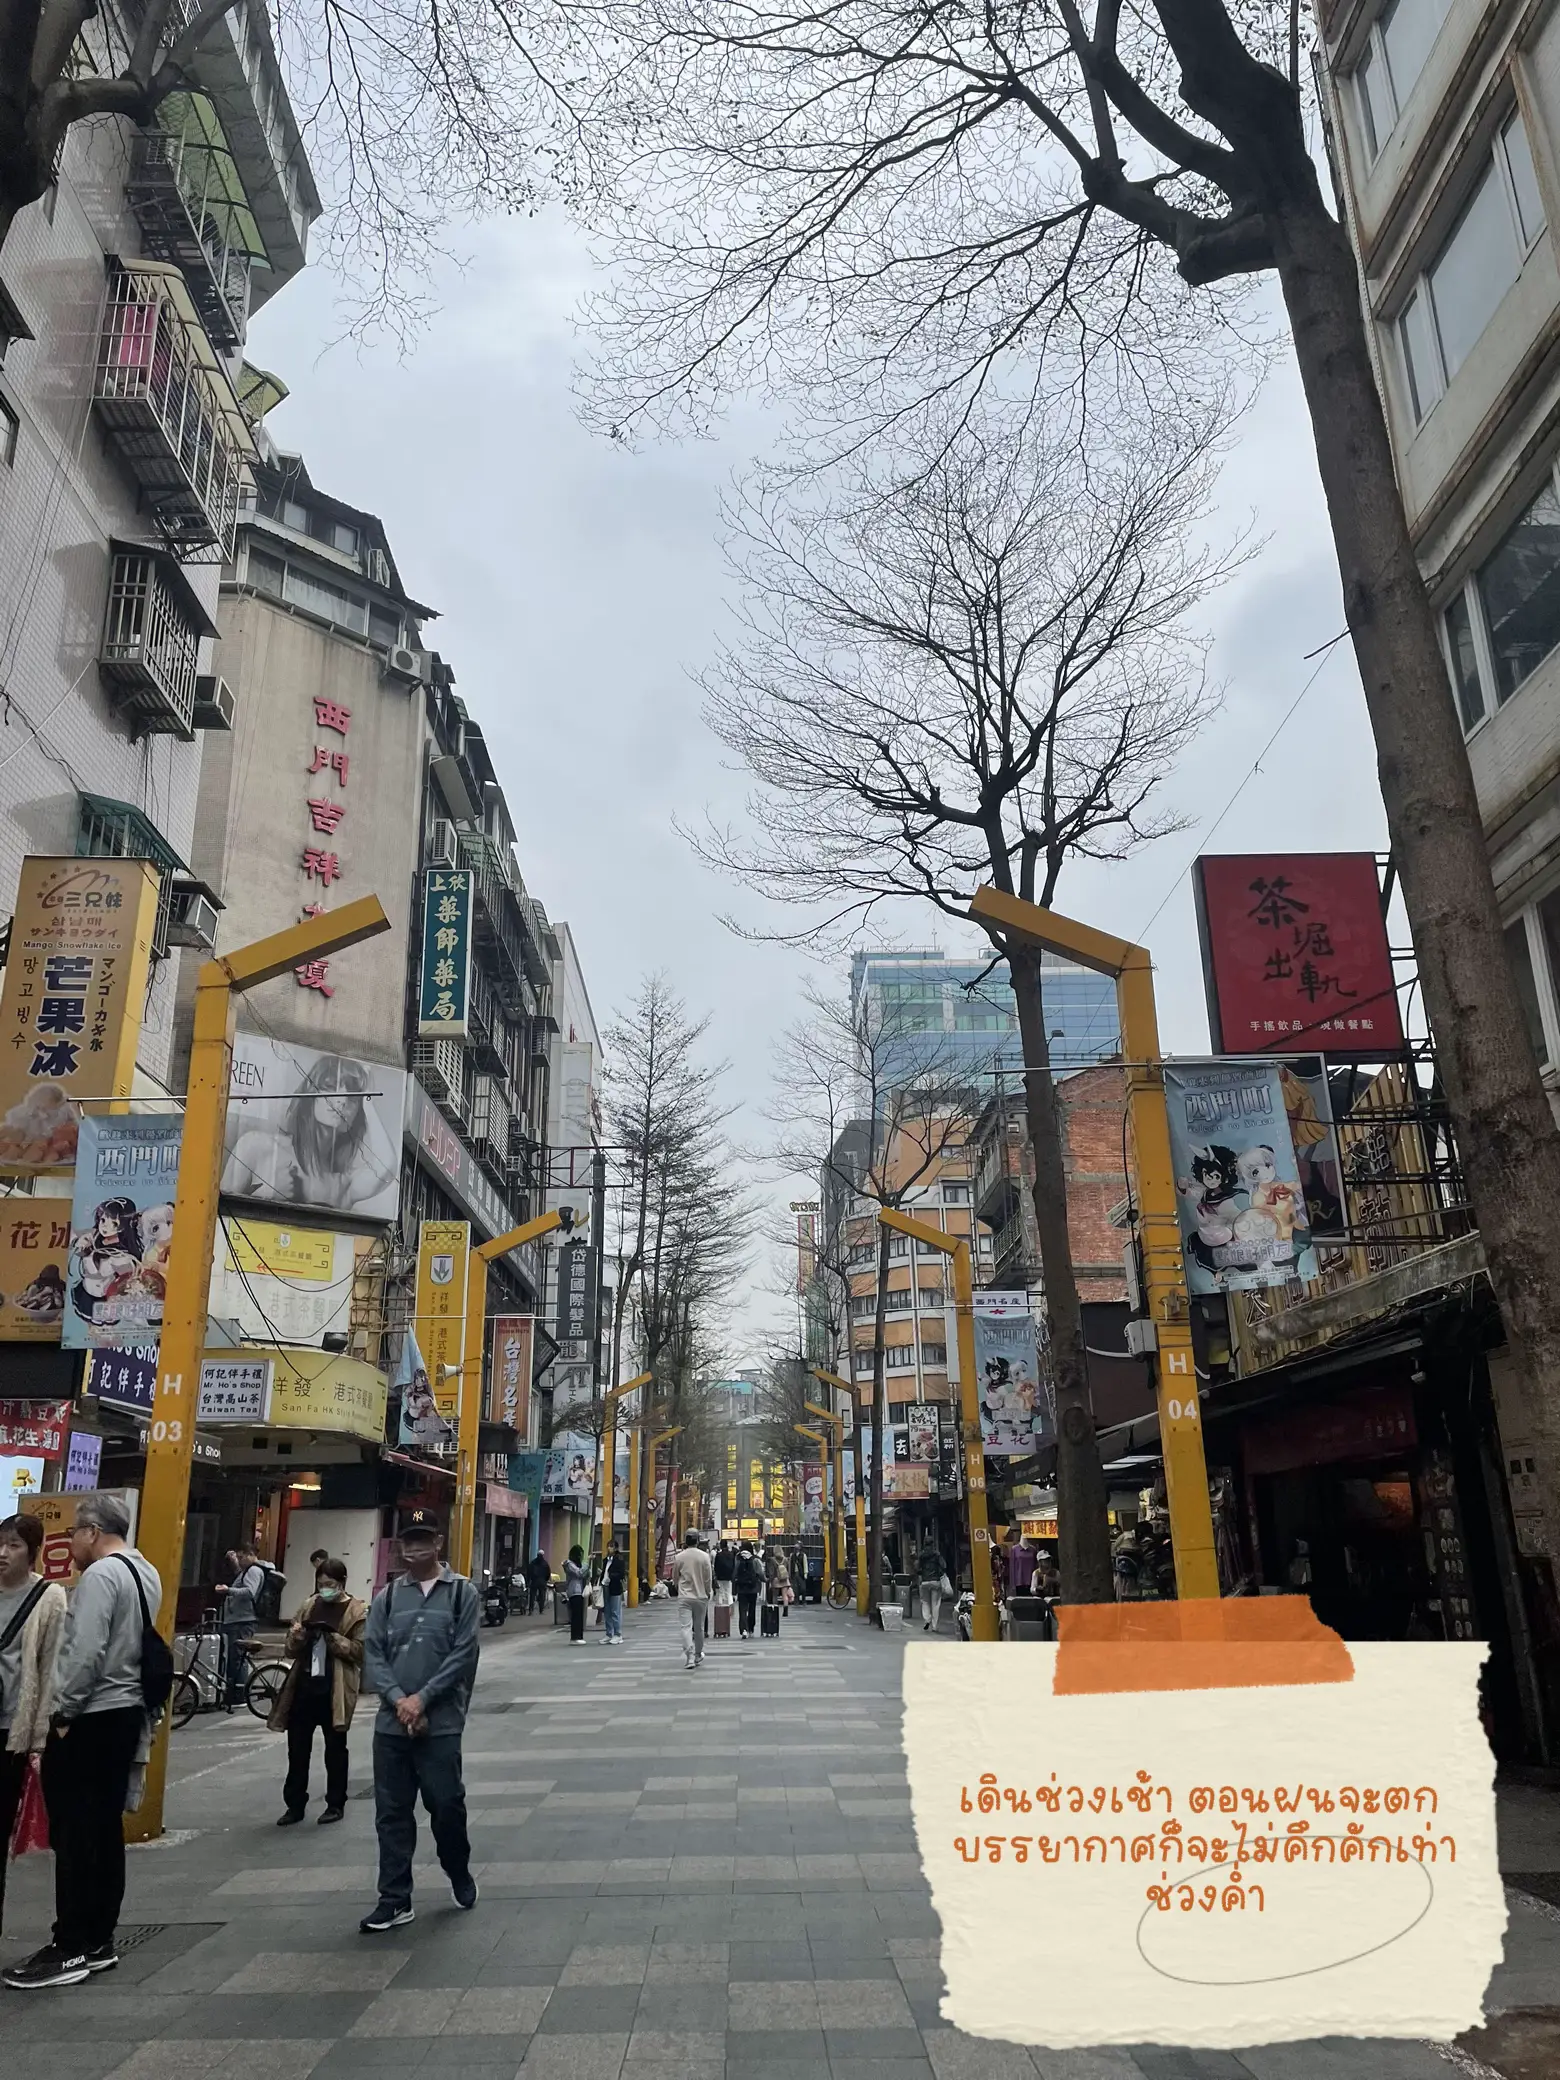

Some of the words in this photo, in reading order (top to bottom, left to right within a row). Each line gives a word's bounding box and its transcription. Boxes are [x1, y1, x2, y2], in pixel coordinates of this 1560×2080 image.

[23, 941, 53, 950] Mango
[57, 940, 104, 950] Snowflake
[108, 942, 122, 950] Ice
[11, 957, 39, 1049] 망고빙수
[28, 955, 94, 1077] 芒果冰
[1184, 1084, 1273, 1123] 西門町
[0, 1221, 71, 1249] 花冰
[205, 1368, 262, 1379] 何記伴手禮
[1168, 1353, 1188, 1374] H
[163, 1374, 182, 1395] H
[203, 1393, 259, 1404] 台灣高山茶
[281, 1403, 302, 1412] San
[307, 1405, 318, 1413] Fa
[322, 1406, 334, 1414] HK
[1168, 1399, 1198, 1421] 04
[152, 1421, 183, 1442] 03
[971, 1454, 980, 1464] H
[970, 1478, 984, 1488] 06
[62, 1955, 86, 1969] HOKA
